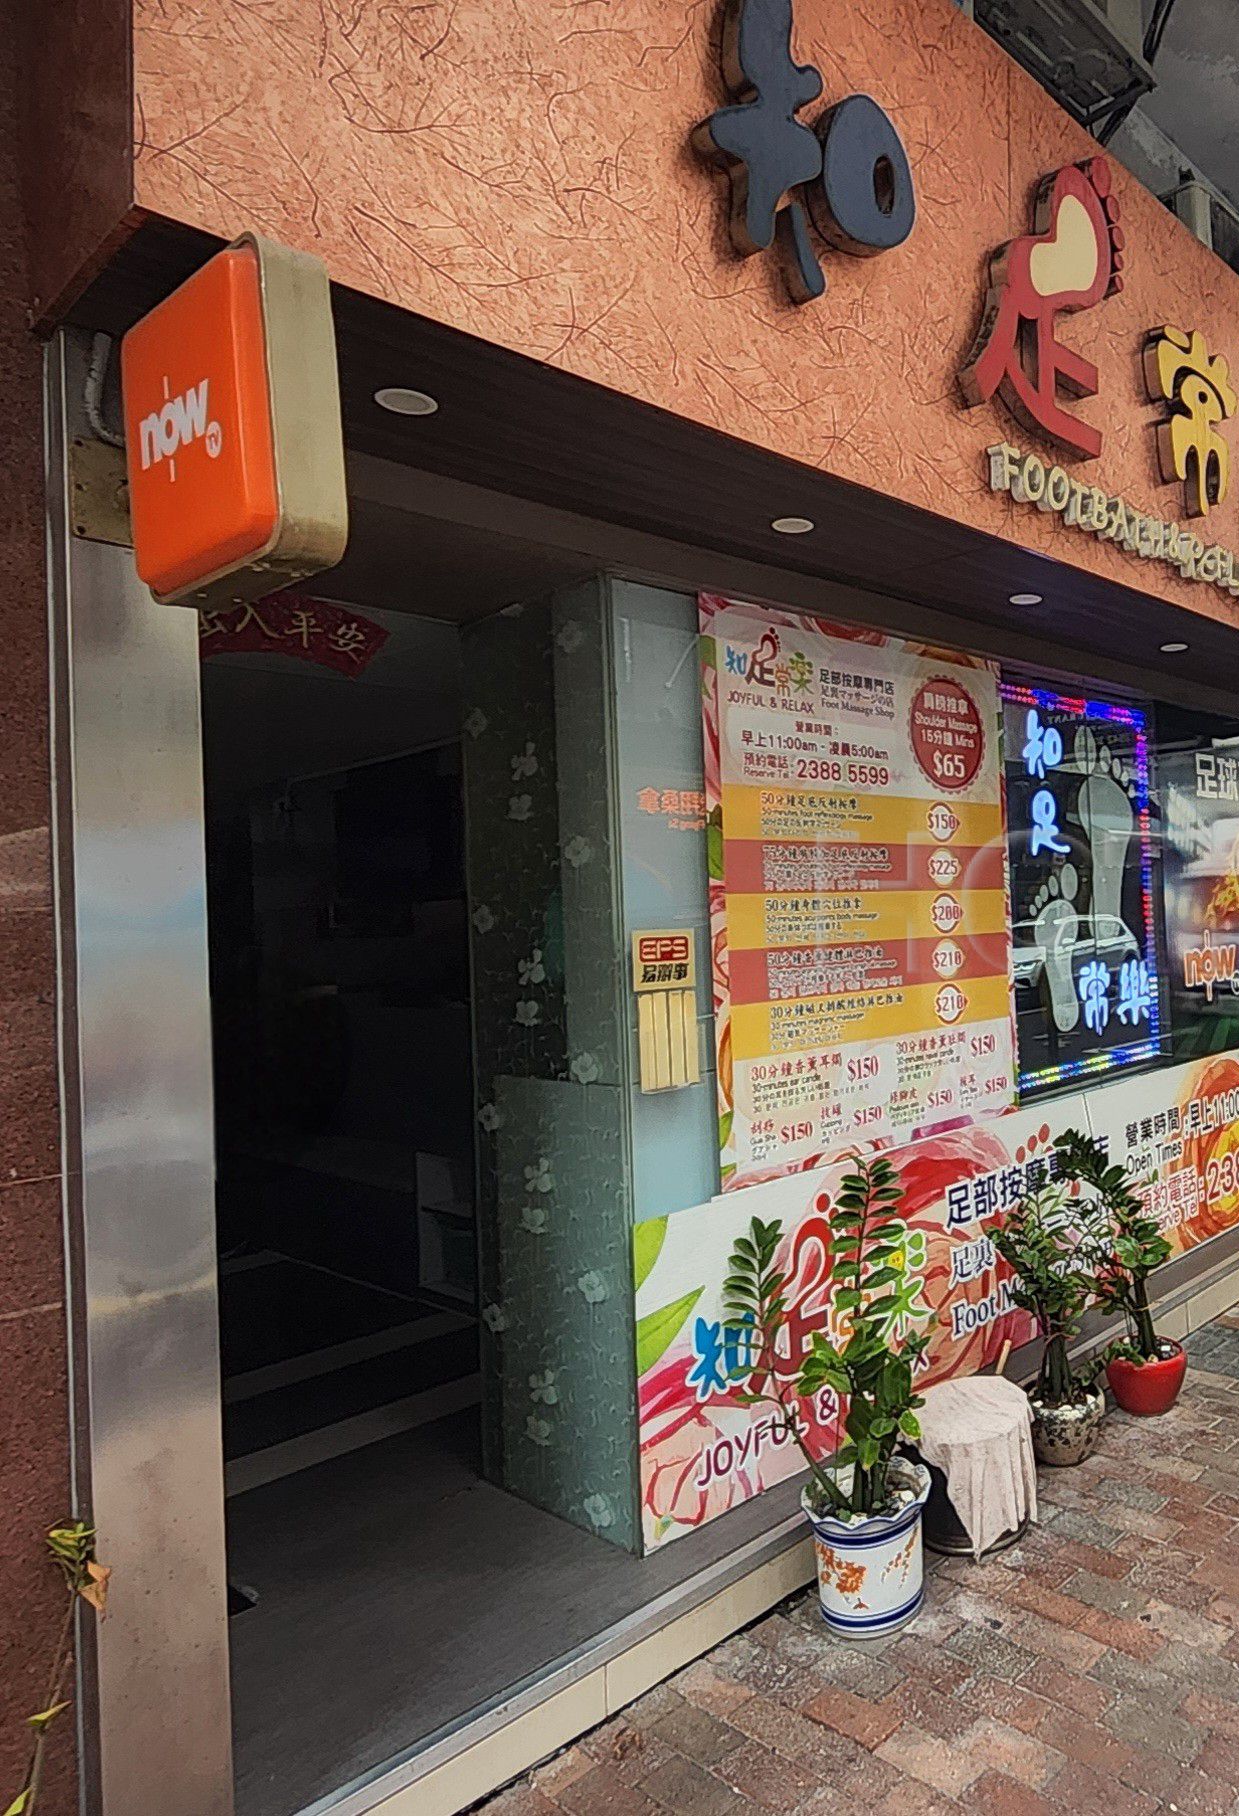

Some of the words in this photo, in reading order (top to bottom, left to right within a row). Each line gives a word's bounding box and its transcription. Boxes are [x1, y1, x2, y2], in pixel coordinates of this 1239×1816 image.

[140, 378, 209, 482] now
[819, 668, 896, 696] 足部按摩專門店
[726, 690, 766, 708] JOYFUL
[769, 696, 778, 709] &
[781, 698, 815, 716] RELAX
[821, 698, 840, 710] Foot
[840, 700, 874, 717] Massage
[875, 706, 896, 721] Shop
[796, 758, 842, 782] 2388
[848, 763, 890, 786] 5599
[932, 749, 966, 779] $65
[1022, 708, 1072, 856] 知足
[927, 813, 956, 830] $150
[928, 860, 959, 877] $225
[931, 904, 960, 922] $200
[641, 938, 688, 961] EPS
[932, 951, 961, 969] $210
[1184, 934, 1237, 998] now
[935, 996, 965, 1014] $210
[1079, 959, 1151, 1036] 常樂
[970, 1033, 996, 1059] $150
[847, 1055, 880, 1083] $150
[984, 1075, 1009, 1095] $150
[926, 1088, 954, 1110] $150
[852, 1105, 883, 1128] $150
[780, 1120, 814, 1145] $150
[1126, 1152, 1153, 1177] Open
[1154, 1141, 1183, 1164] Times
[951, 1296, 998, 1338] Foot
[818, 1387, 838, 1425] &
